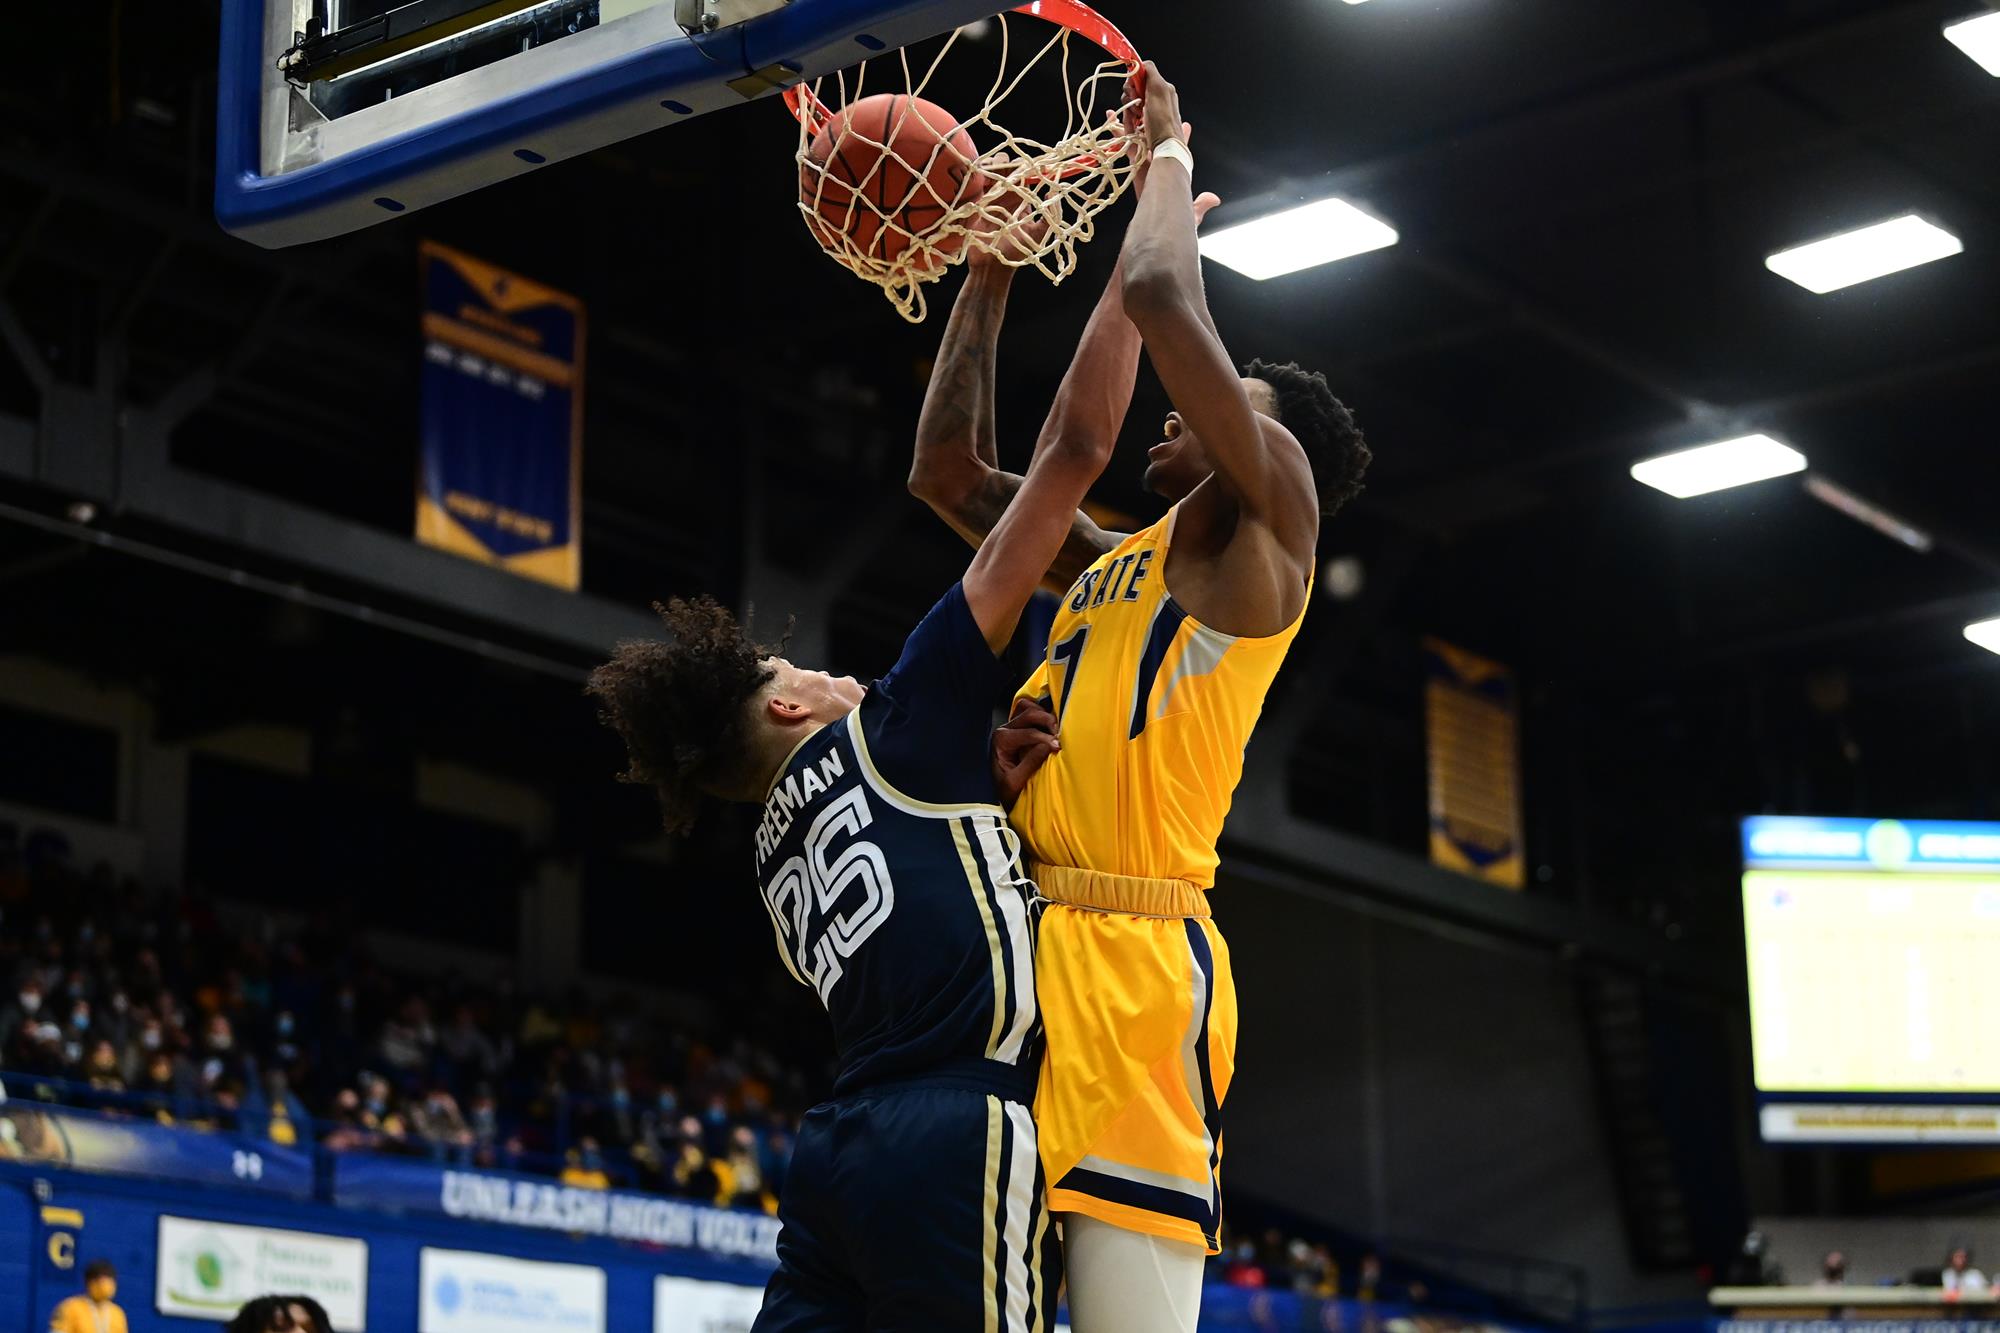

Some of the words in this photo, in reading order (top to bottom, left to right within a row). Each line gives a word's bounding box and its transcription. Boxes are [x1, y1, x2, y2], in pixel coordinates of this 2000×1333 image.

[755, 746, 845, 868] REEMAN
[766, 784, 894, 1012] 25
[442, 1170, 608, 1235] UNLEASH
[609, 1193, 695, 1247] HIGH
